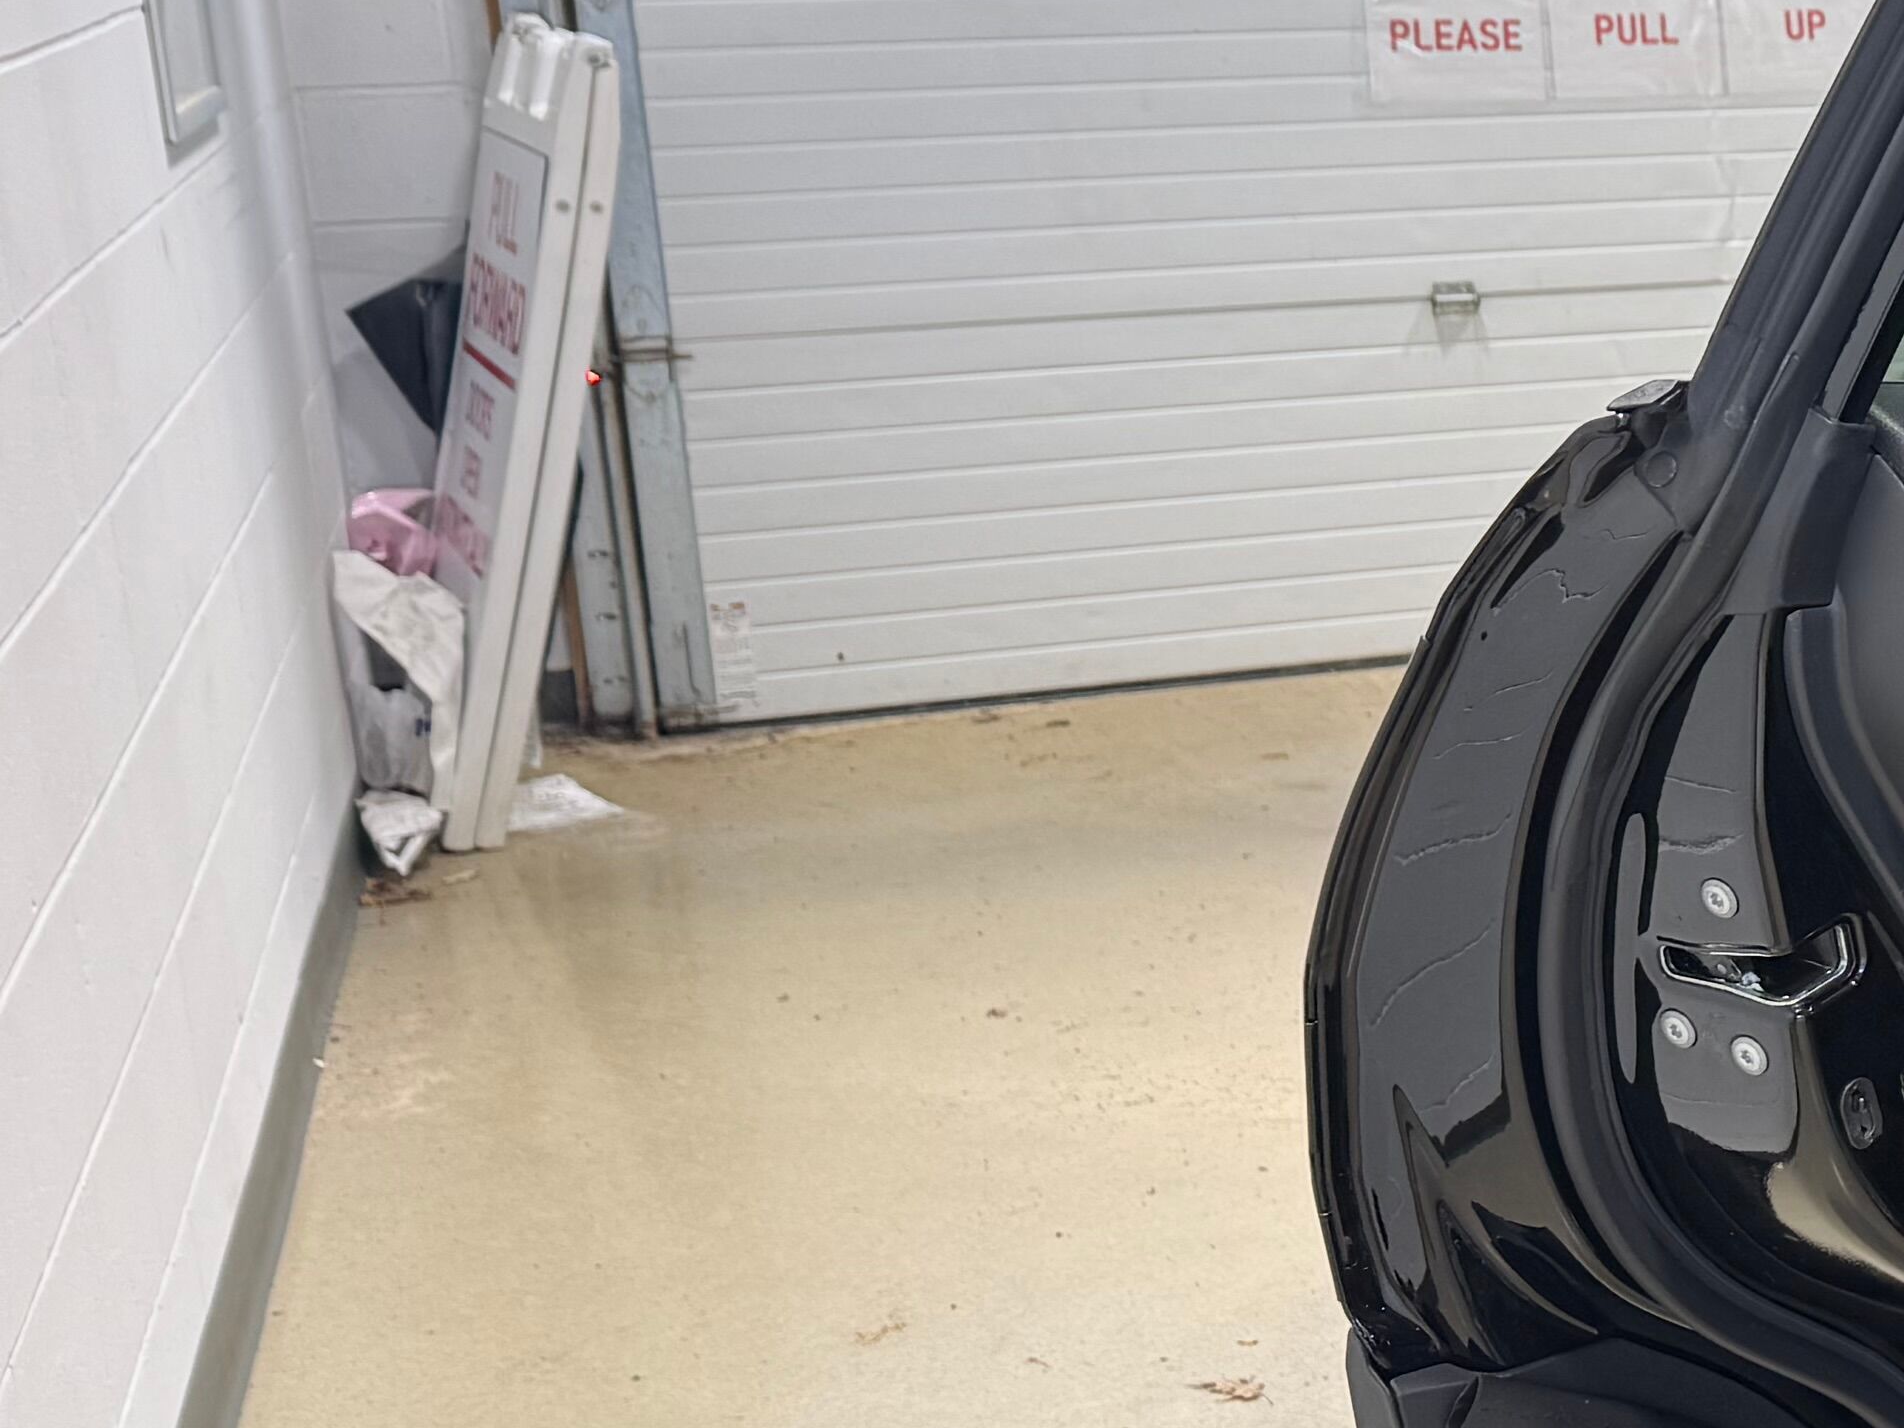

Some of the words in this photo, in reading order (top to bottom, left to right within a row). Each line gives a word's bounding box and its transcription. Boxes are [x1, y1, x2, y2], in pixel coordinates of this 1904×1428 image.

[1388, 18, 1523, 53] PLEASE
[1594, 12, 1680, 46] PULL
[1784, 9, 1827, 41] UP
